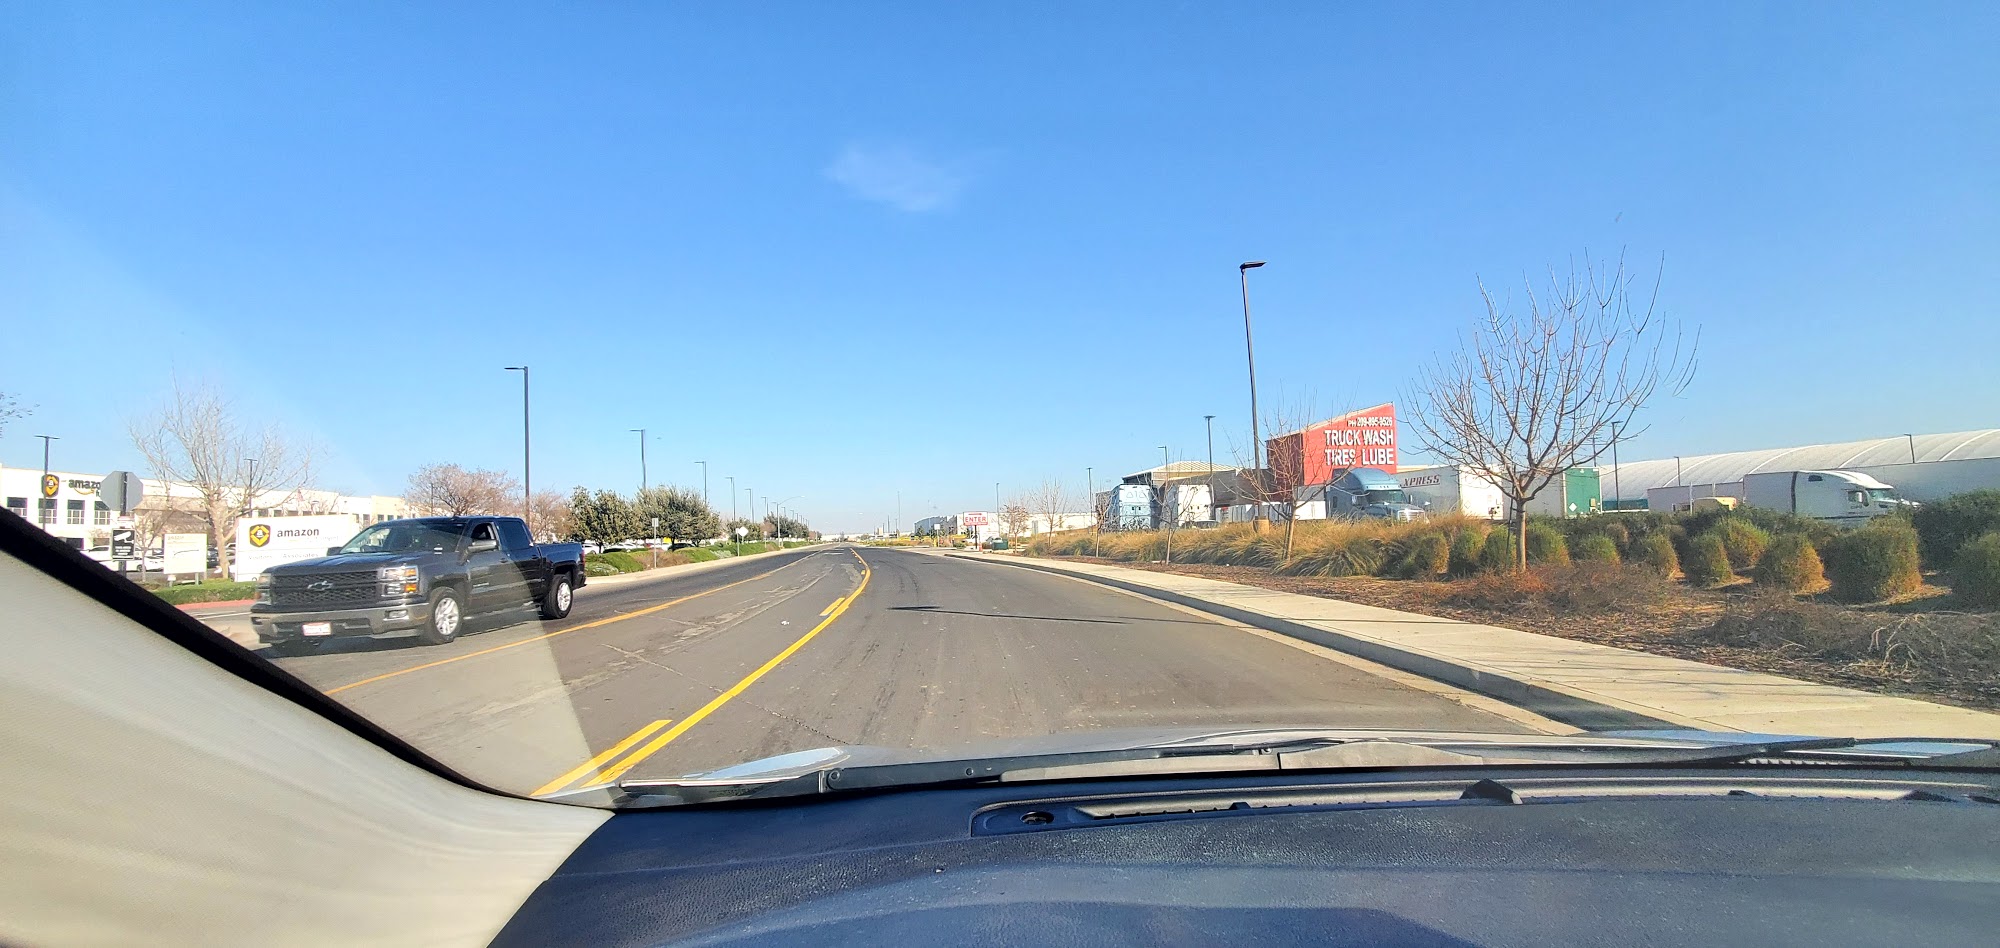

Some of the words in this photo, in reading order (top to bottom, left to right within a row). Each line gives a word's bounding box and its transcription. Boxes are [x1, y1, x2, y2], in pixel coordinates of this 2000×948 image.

[1324, 429, 1361, 446] TRUCK
[1362, 429, 1394, 446] WASH
[1324, 448, 1357, 466] TIRES
[1361, 448, 1395, 466] LUBE
[68, 479, 101, 489] amazo
[1400, 474, 1441, 488] XPRESS
[277, 528, 320, 538] amazon
